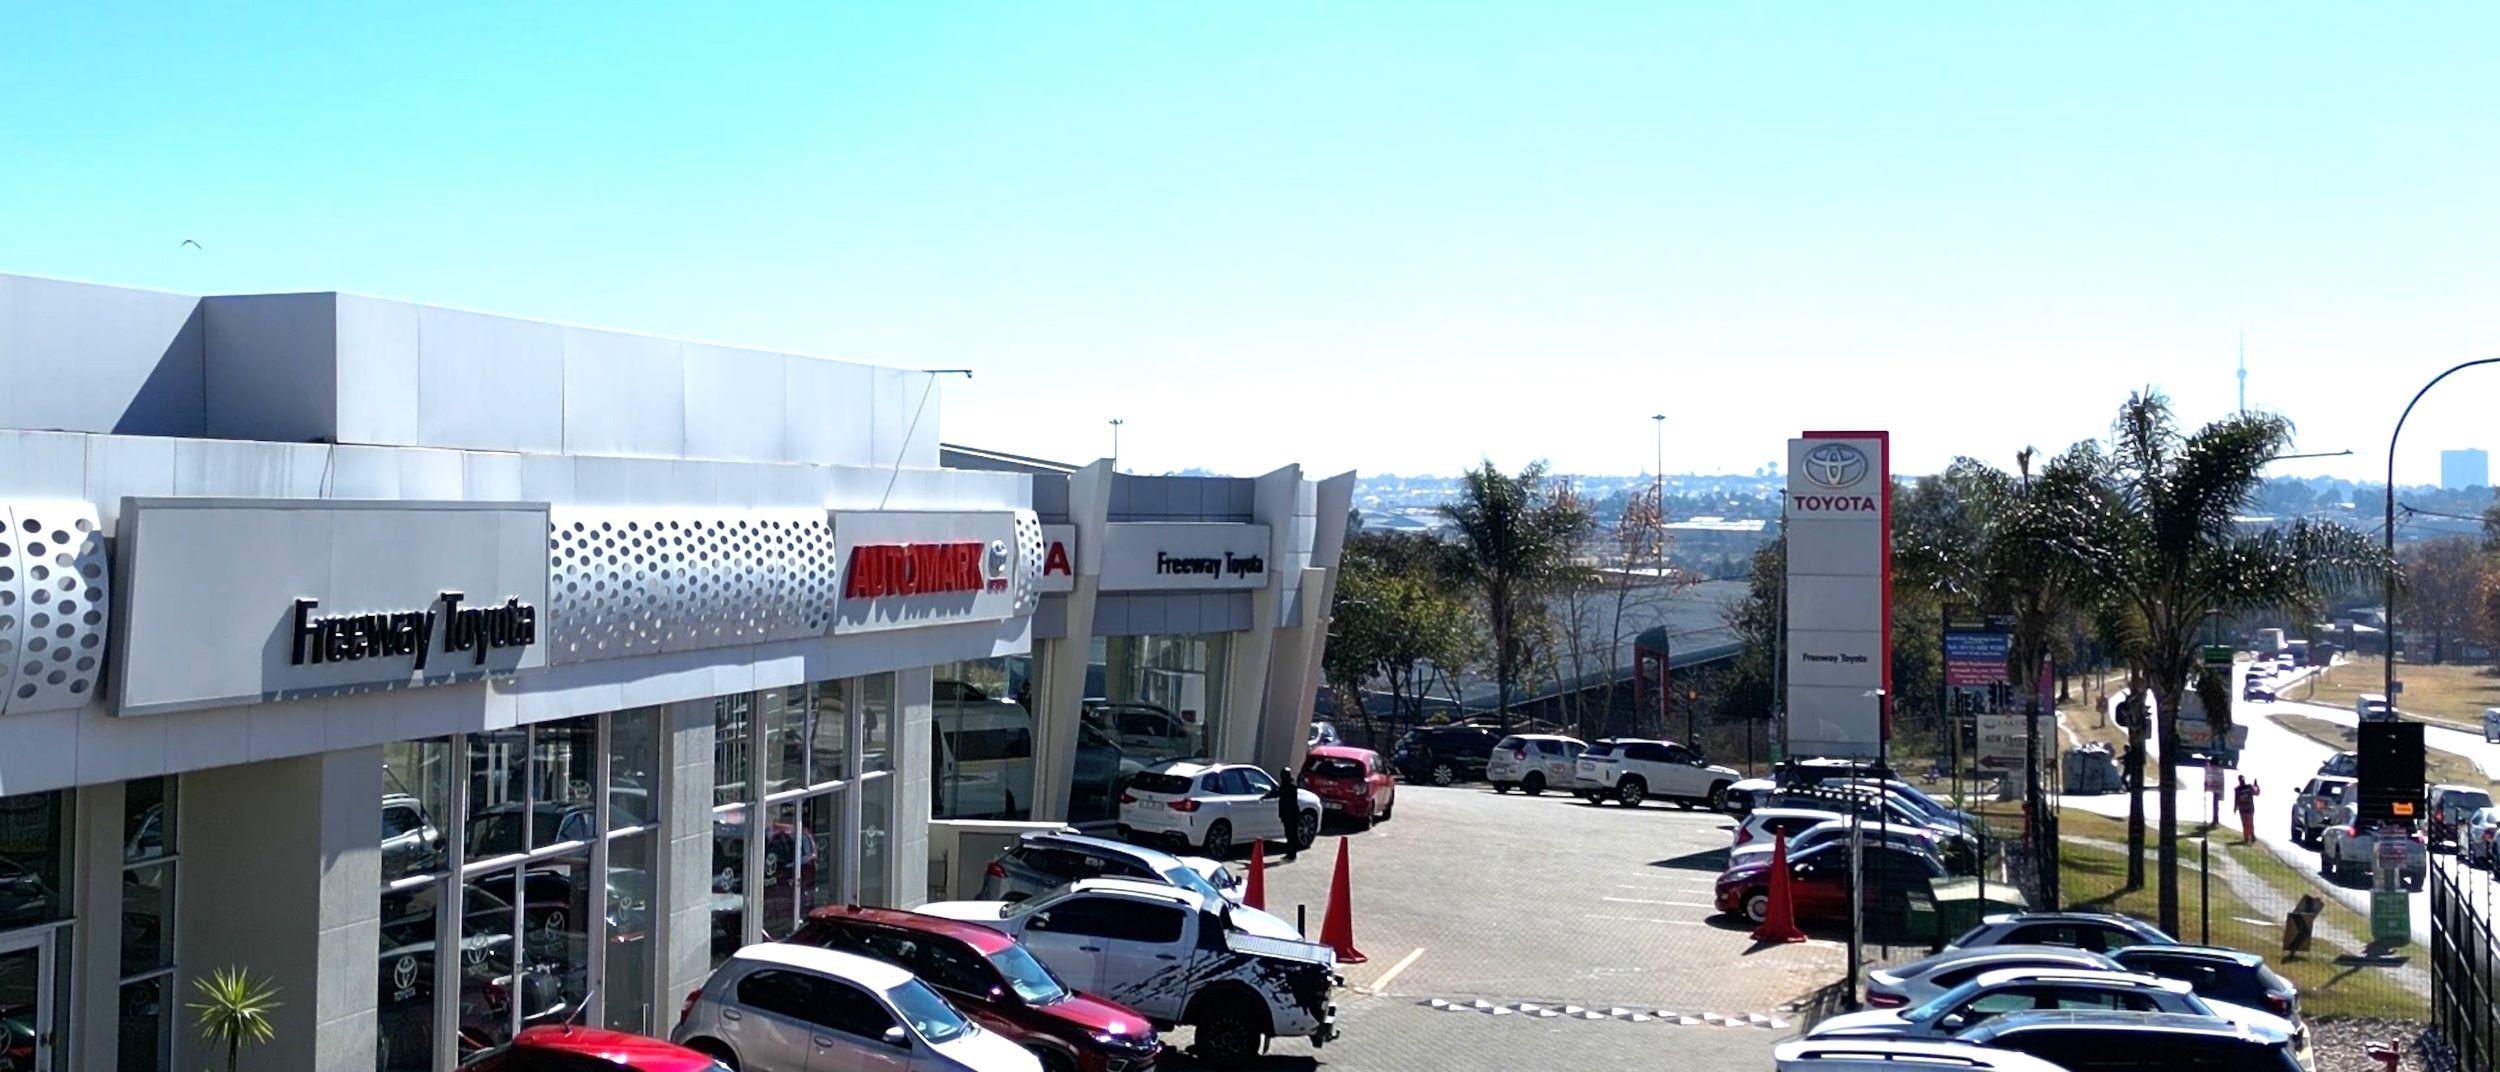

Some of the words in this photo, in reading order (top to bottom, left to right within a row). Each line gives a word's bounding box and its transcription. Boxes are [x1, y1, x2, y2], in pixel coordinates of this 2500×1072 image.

[1794, 496, 1876, 512] TOYOTA
[846, 542, 984, 600] AUTOMARK
[1043, 541, 1072, 577] A
[1157, 551, 1222, 580] Freeway
[1224, 551, 1264, 579] Toyota
[291, 597, 437, 670] Freeway
[440, 590, 536, 665] Toyota
[1802, 653, 1838, 664] Freeway
[1841, 653, 1867, 664] Toyota
